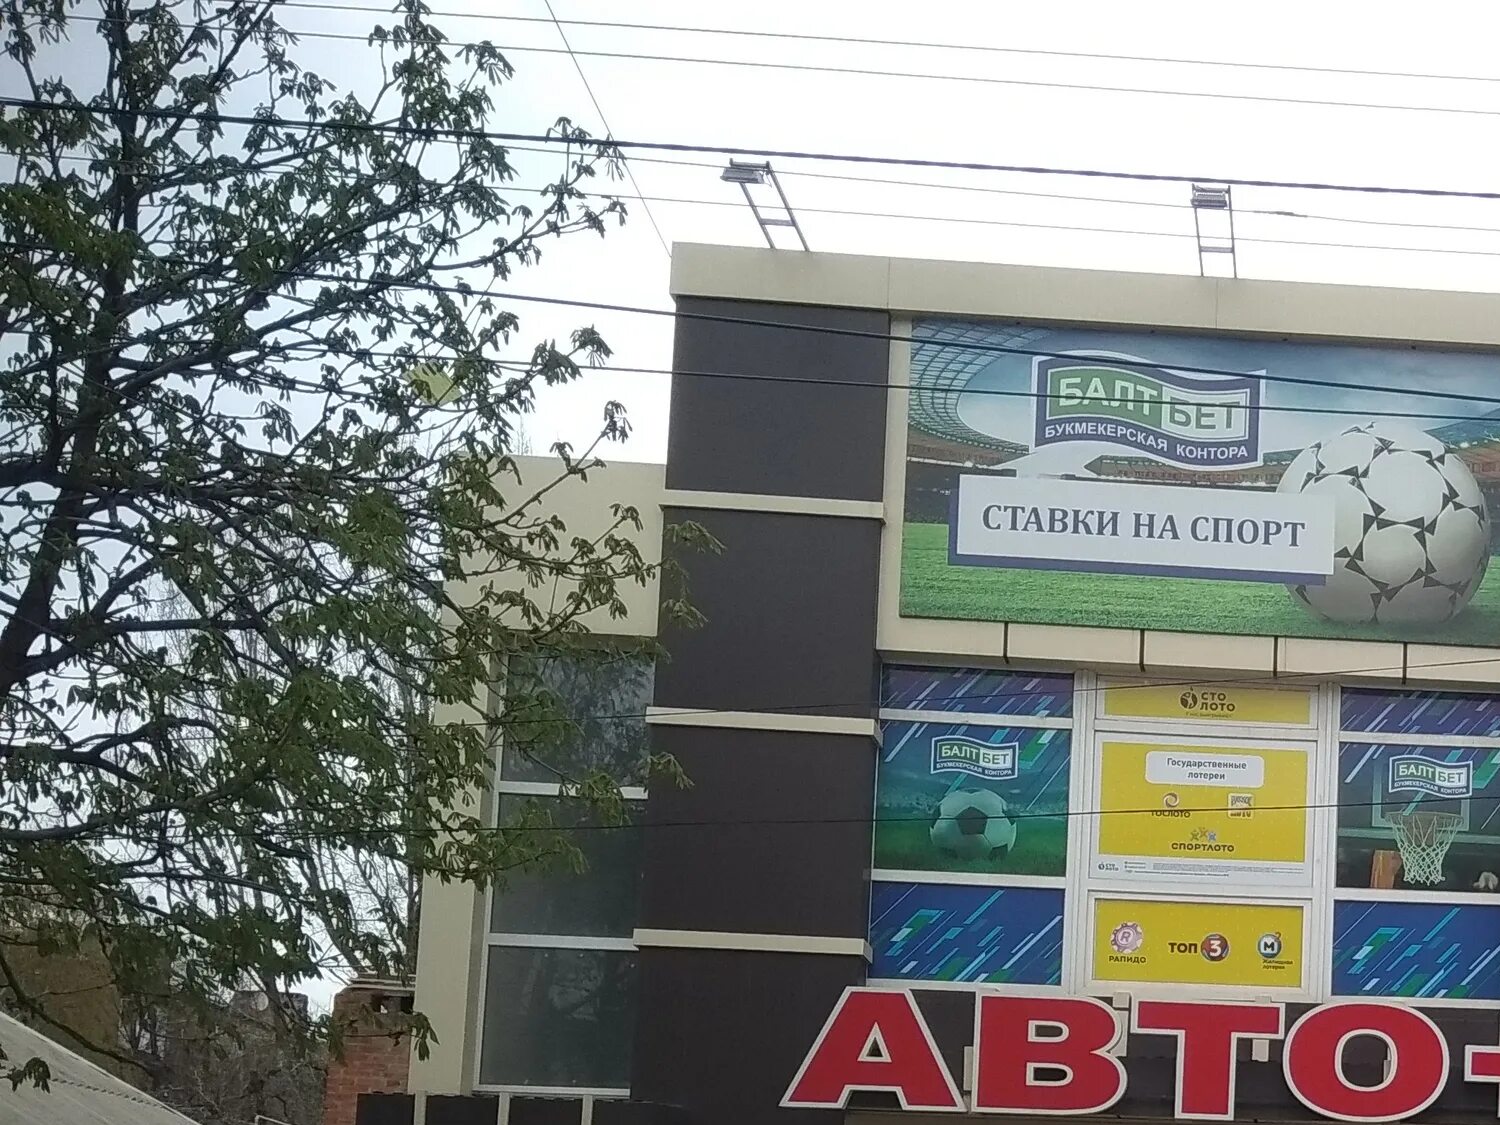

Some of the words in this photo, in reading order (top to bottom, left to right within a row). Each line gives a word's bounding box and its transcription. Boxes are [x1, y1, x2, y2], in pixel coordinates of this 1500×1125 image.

[1059, 377, 1158, 416] БАЛТ
[1168, 396, 1241, 430] БЕТ
[1045, 422, 1168, 452] БУКМЕКЕРСКАЯ
[1176, 443, 1248, 460] КОНТОРА
[982, 504, 1121, 537] СТАВКИ
[1132, 511, 1181, 540] НА
[1190, 515, 1306, 547] СПОРТ
[1201, 691, 1227, 702] СТО
[1199, 701, 1236, 712] ЛОТО
[941, 745, 979, 760] БАЛТ
[982, 753, 1010, 765] БЕТ
[936, 762, 983, 773] БУКМЕКЕРСКАЯ
[1166, 757, 1247, 770] Государственные
[1187, 771, 1226, 781] лотереи
[1399, 764, 1435, 779] БАЛТ
[1437, 771, 1464, 783] БЕТ
[1394, 780, 1439, 792] БУКМЕКЕРСКАЯ
[1171, 842, 1235, 853] СПОРТЛОТО
[1168, 942, 1198, 954] ТОП
[1209, 940, 1222, 957] 3
[1108, 955, 1147, 964] РАПИДО
